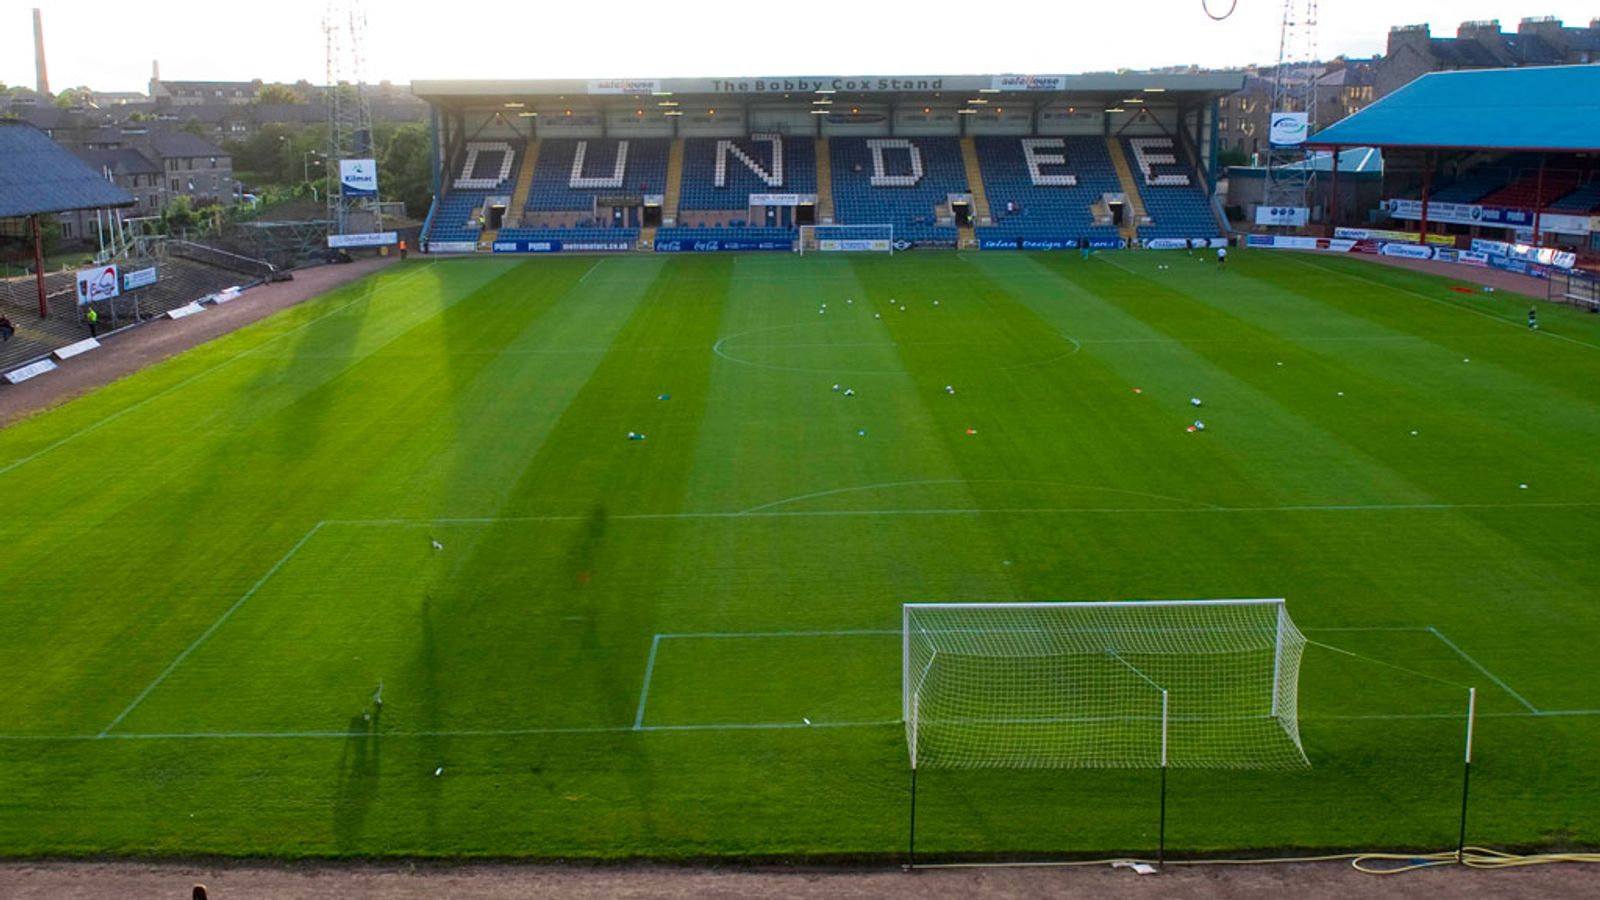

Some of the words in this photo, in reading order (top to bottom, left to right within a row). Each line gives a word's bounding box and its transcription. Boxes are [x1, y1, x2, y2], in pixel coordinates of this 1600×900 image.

[712, 80, 749, 92] The
[755, 79, 823, 93] Bobby
[832, 79, 871, 90] Cox
[878, 78, 943, 90] Stand
[453, 132, 1190, 188] DUNDEE
